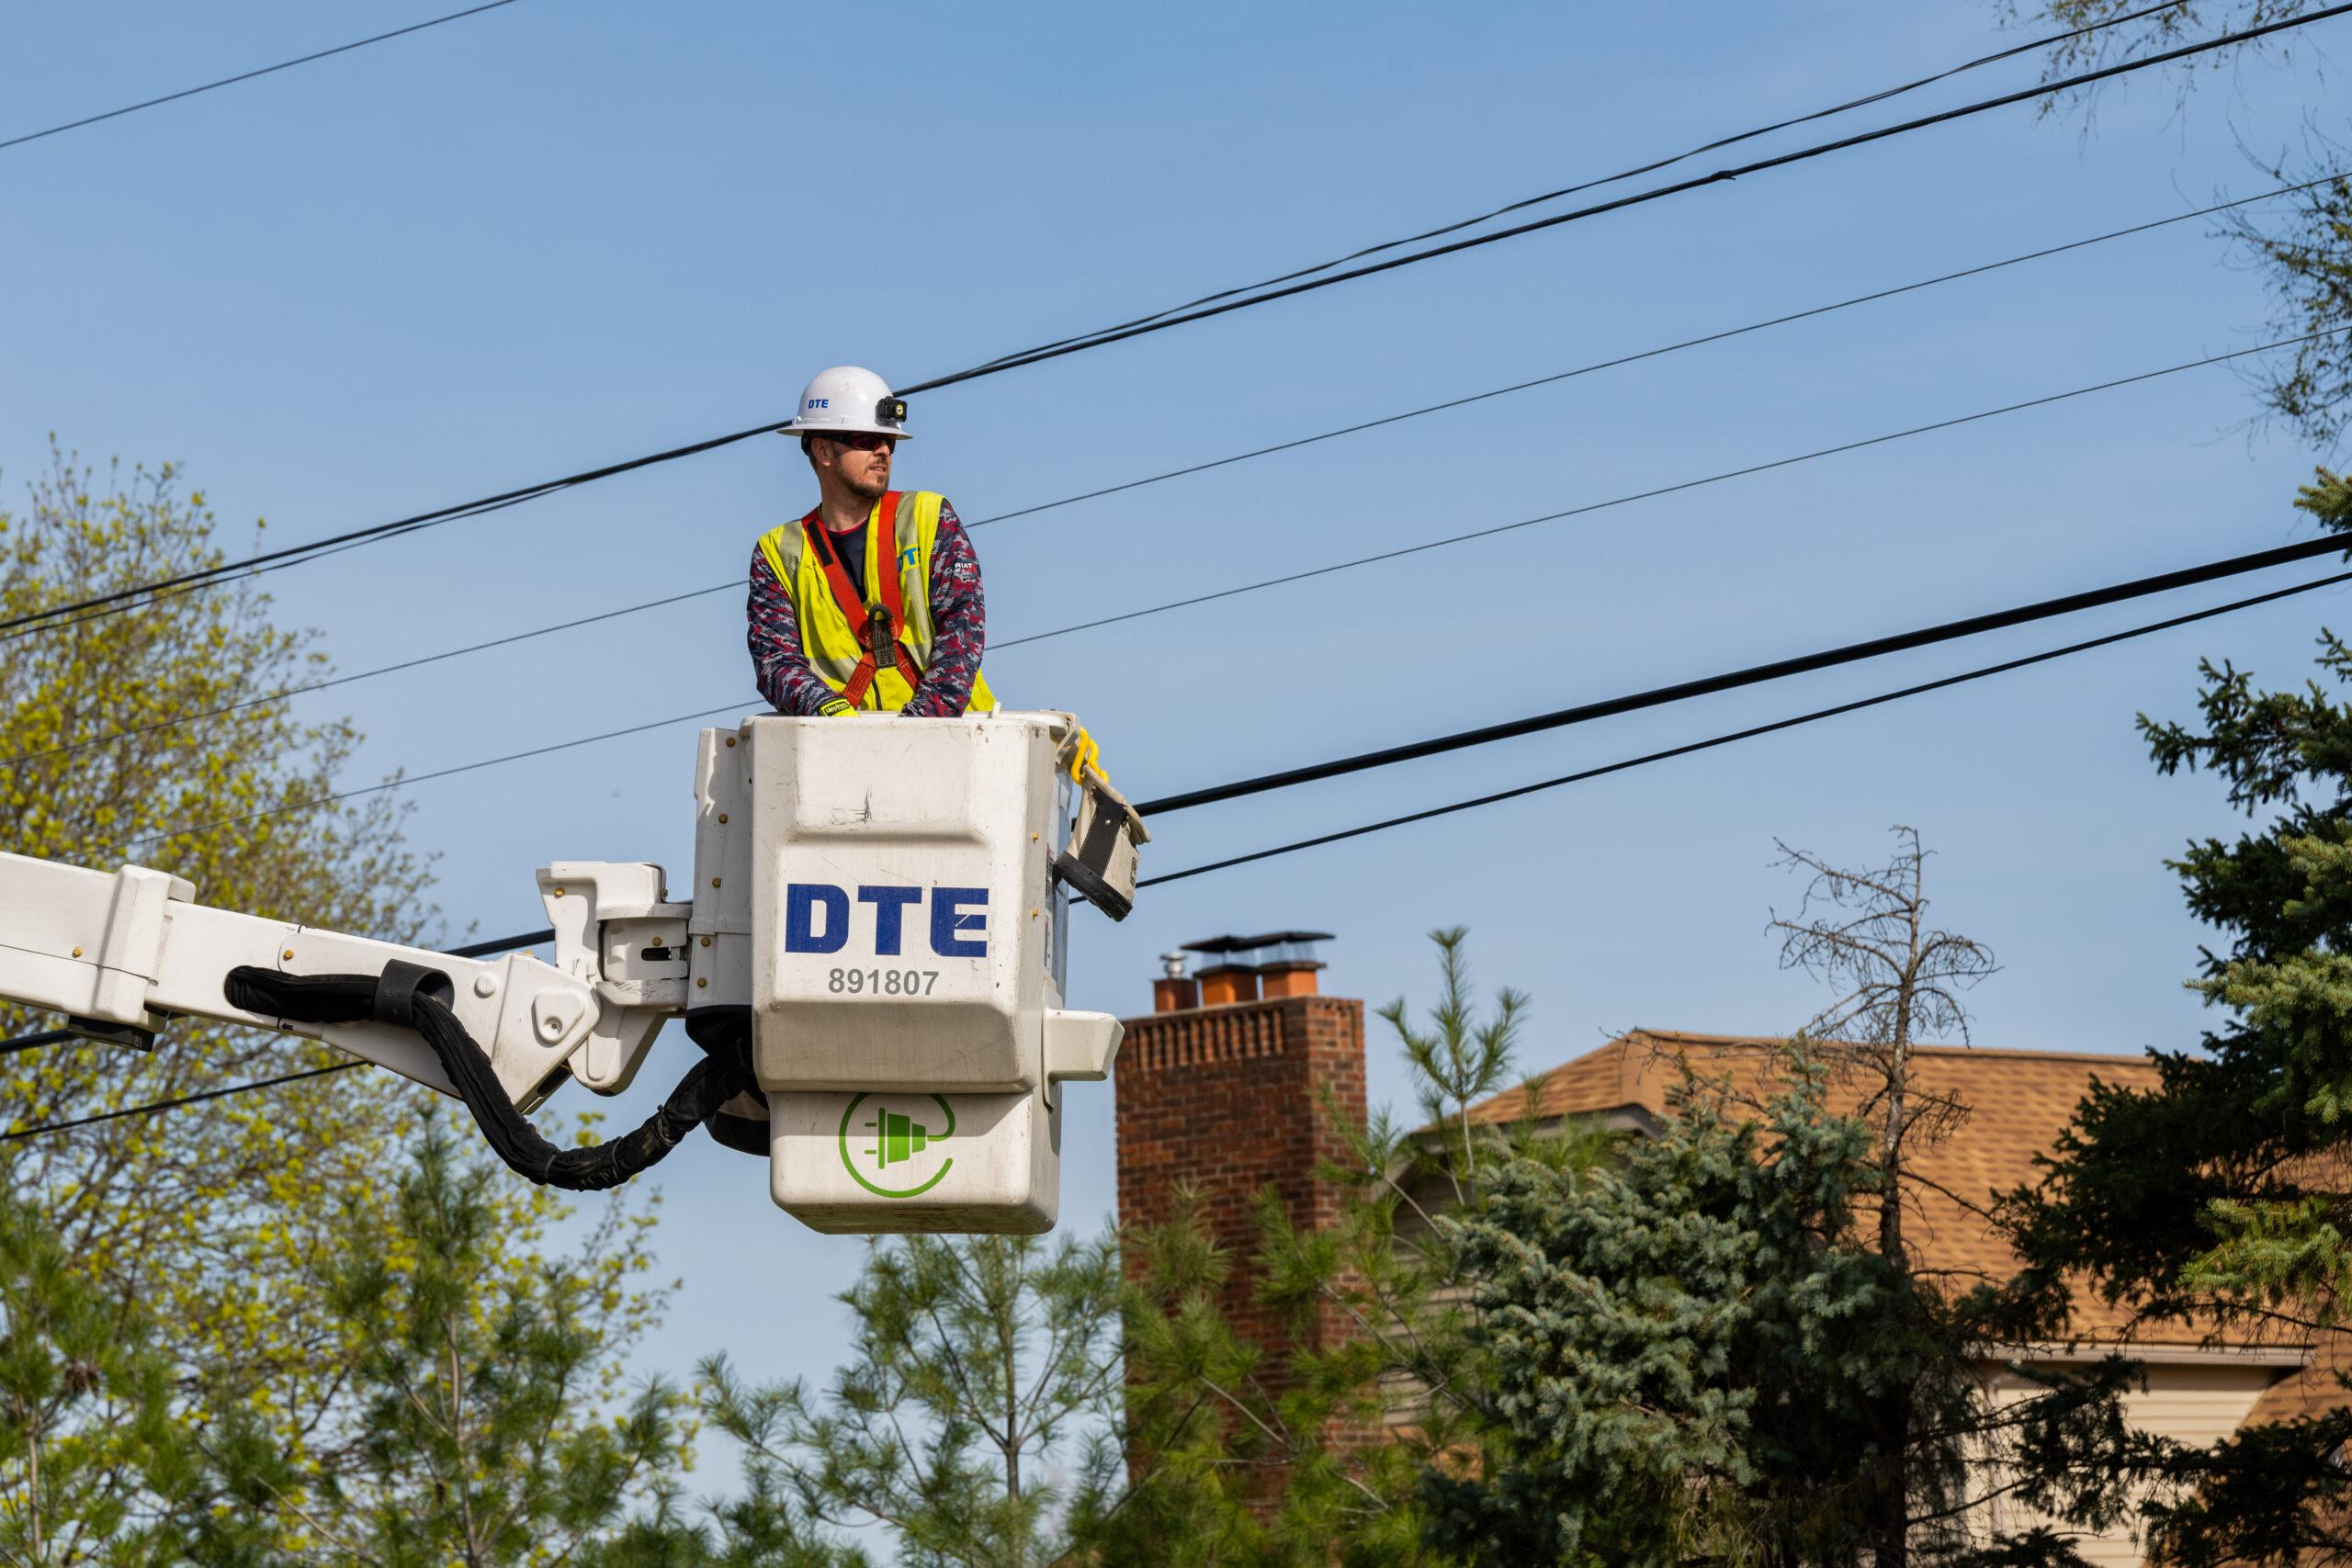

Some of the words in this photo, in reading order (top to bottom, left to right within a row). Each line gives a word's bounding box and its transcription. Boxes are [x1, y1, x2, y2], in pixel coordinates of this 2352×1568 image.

[808, 399, 830, 410] DTE
[785, 883, 989, 958] DTE
[828, 967, 940, 996] 891807
